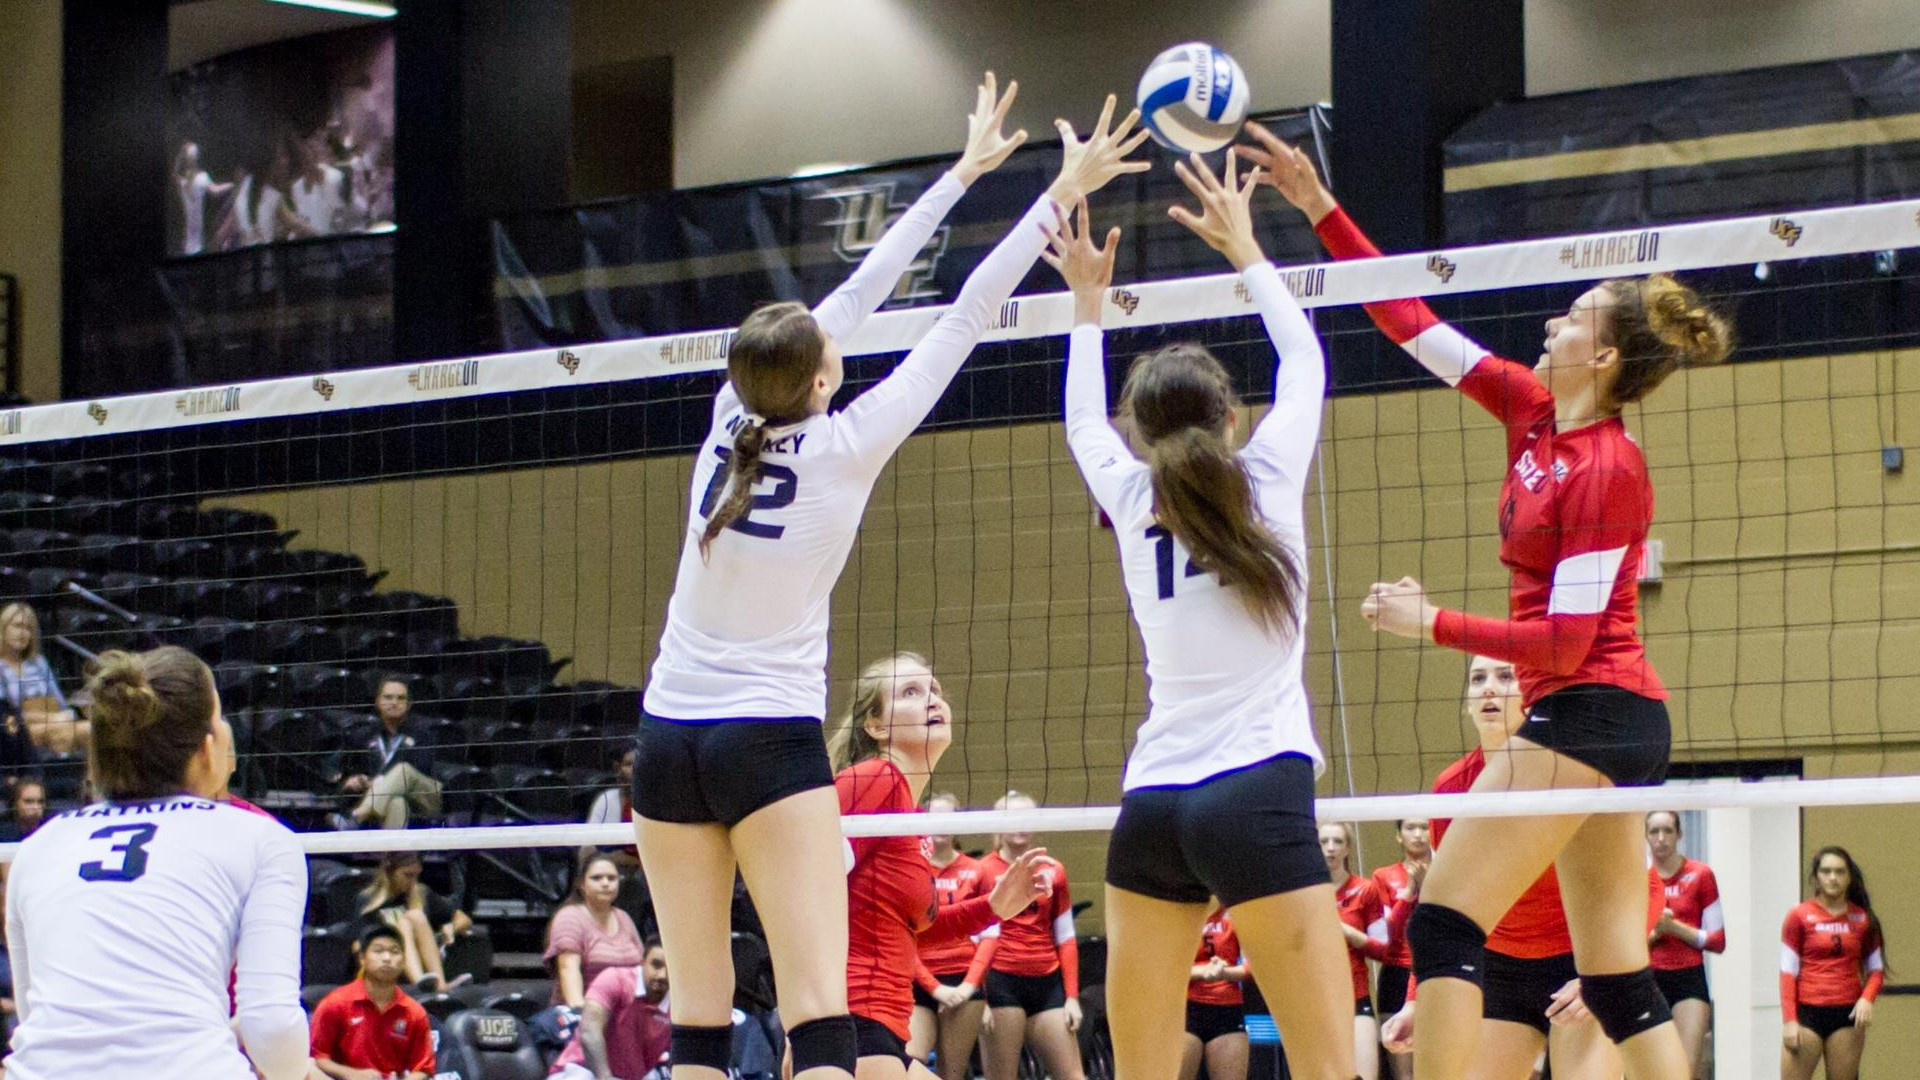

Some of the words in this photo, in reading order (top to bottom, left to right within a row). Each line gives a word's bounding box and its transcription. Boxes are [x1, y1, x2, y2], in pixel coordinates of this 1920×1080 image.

[1769, 218, 1802, 247] UCF
[1426, 255, 1456, 283] UCF
[1110, 288, 1139, 316] UCF
[660, 331, 738, 365] #CHARGEO
[557, 350, 580, 375] UCF
[312, 376, 334, 401] UCF
[78, 822, 159, 883] 3
